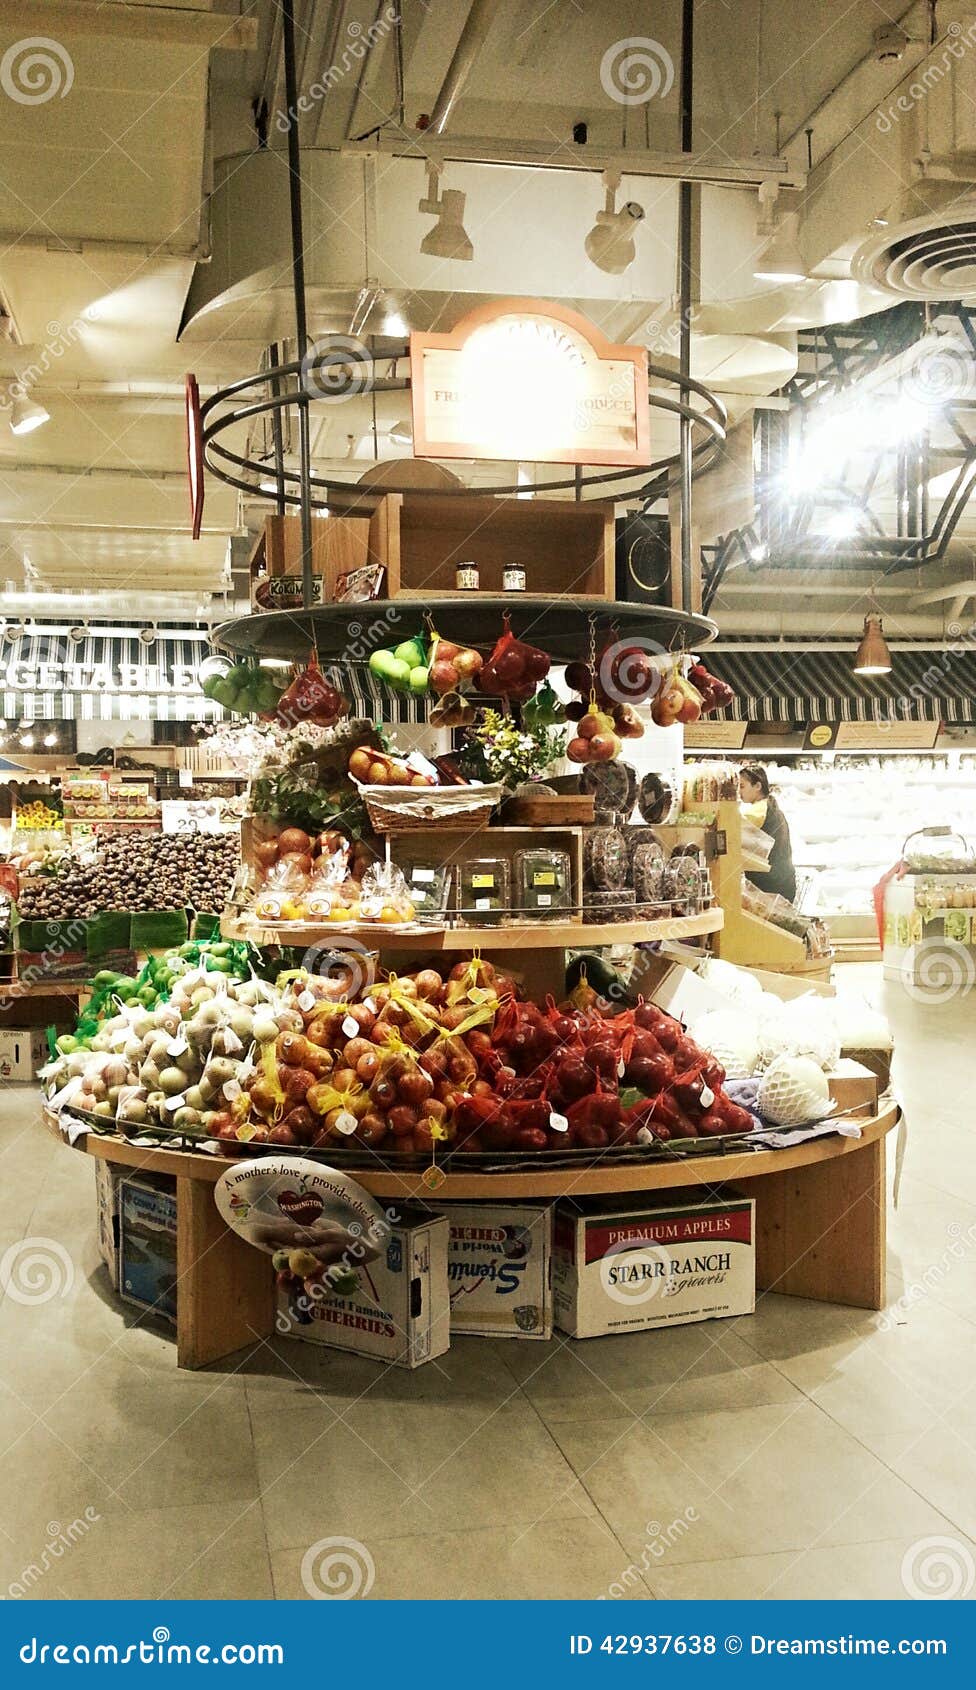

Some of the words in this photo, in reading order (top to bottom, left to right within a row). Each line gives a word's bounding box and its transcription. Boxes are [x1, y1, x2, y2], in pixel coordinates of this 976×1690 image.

[224, 1180, 235, 1191] A
[234, 1164, 279, 1184] mother's
[280, 1164, 301, 1178] love
[352, 1200, 368, 1217] the
[608, 1226, 678, 1244] PREMIUM
[683, 1218, 731, 1236] APPLES
[608, 1262, 665, 1286] STARR
[669, 1252, 731, 1276] RANCH
[676, 1271, 727, 1292] growers
[311, 1306, 396, 1338] CHERRIES
